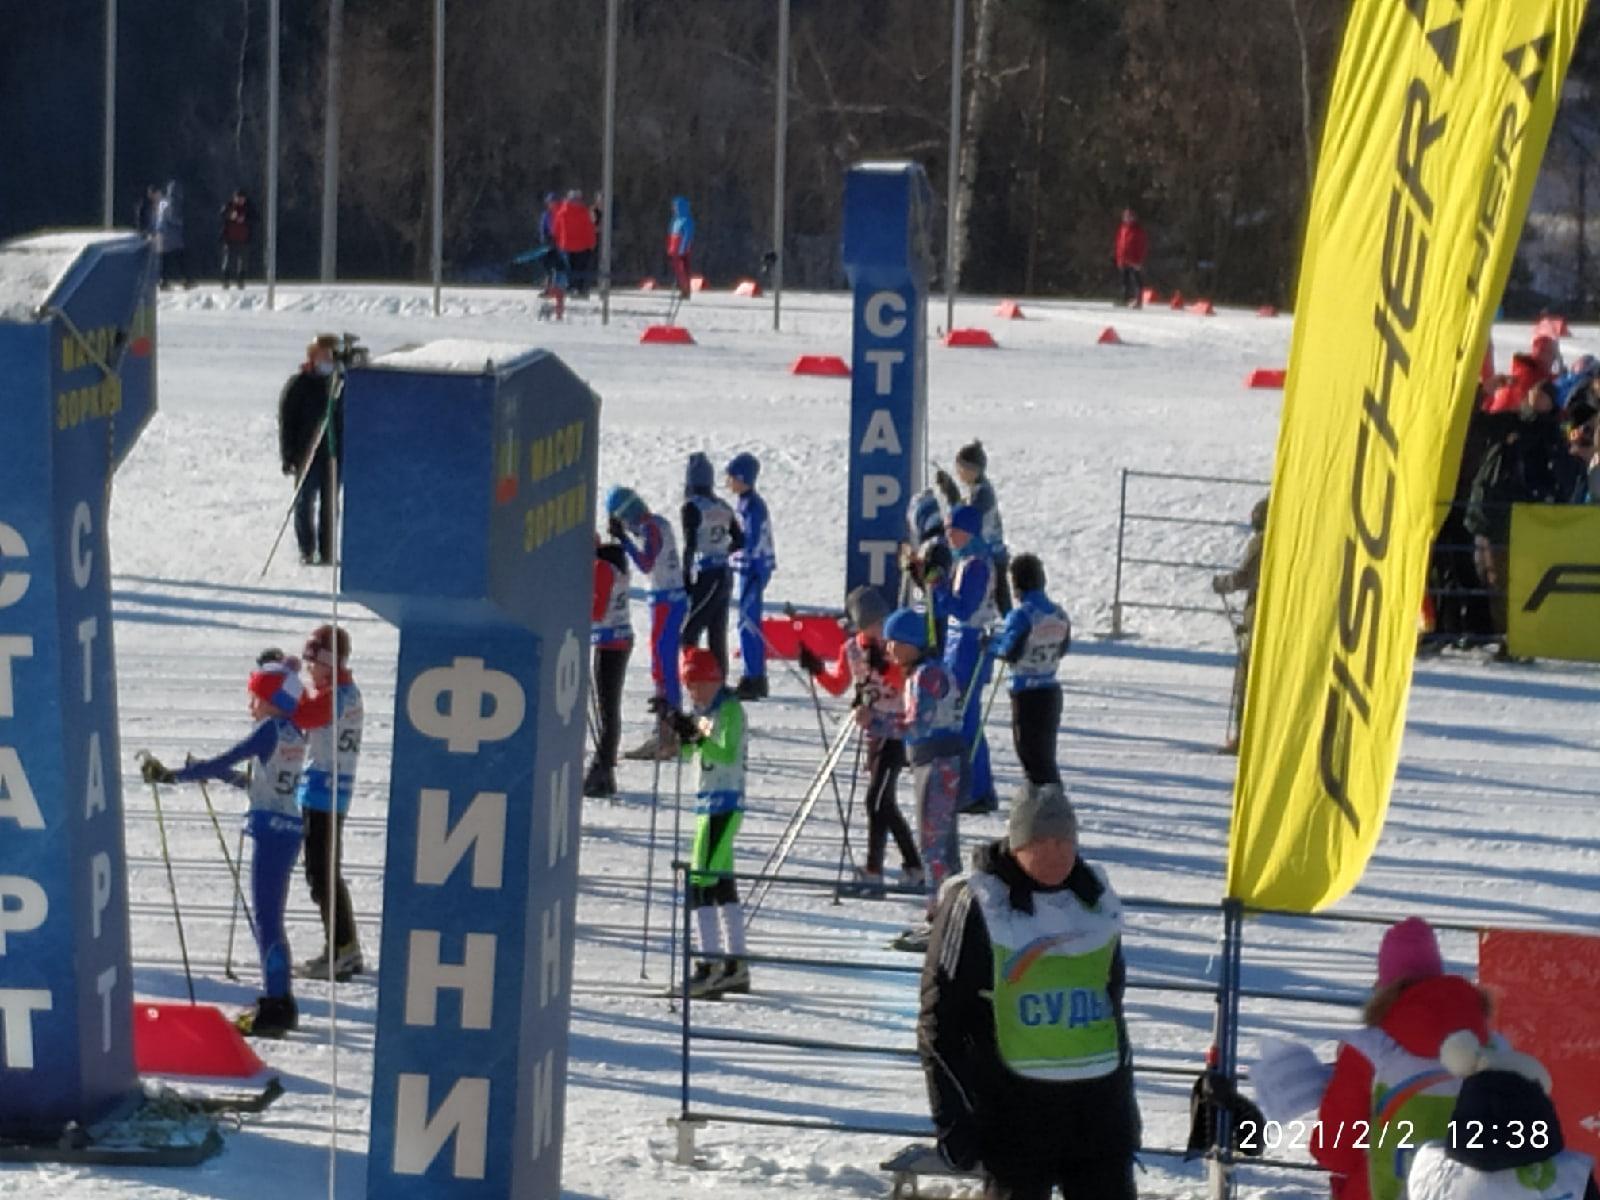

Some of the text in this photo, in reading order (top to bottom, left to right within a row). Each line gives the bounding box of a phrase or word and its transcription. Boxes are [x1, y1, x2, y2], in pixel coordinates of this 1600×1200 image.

[858, 292, 907, 585] СТАРТ
[1320, 77, 1448, 840] FISCHER
[71, 501, 118, 1053] СТАРТ
